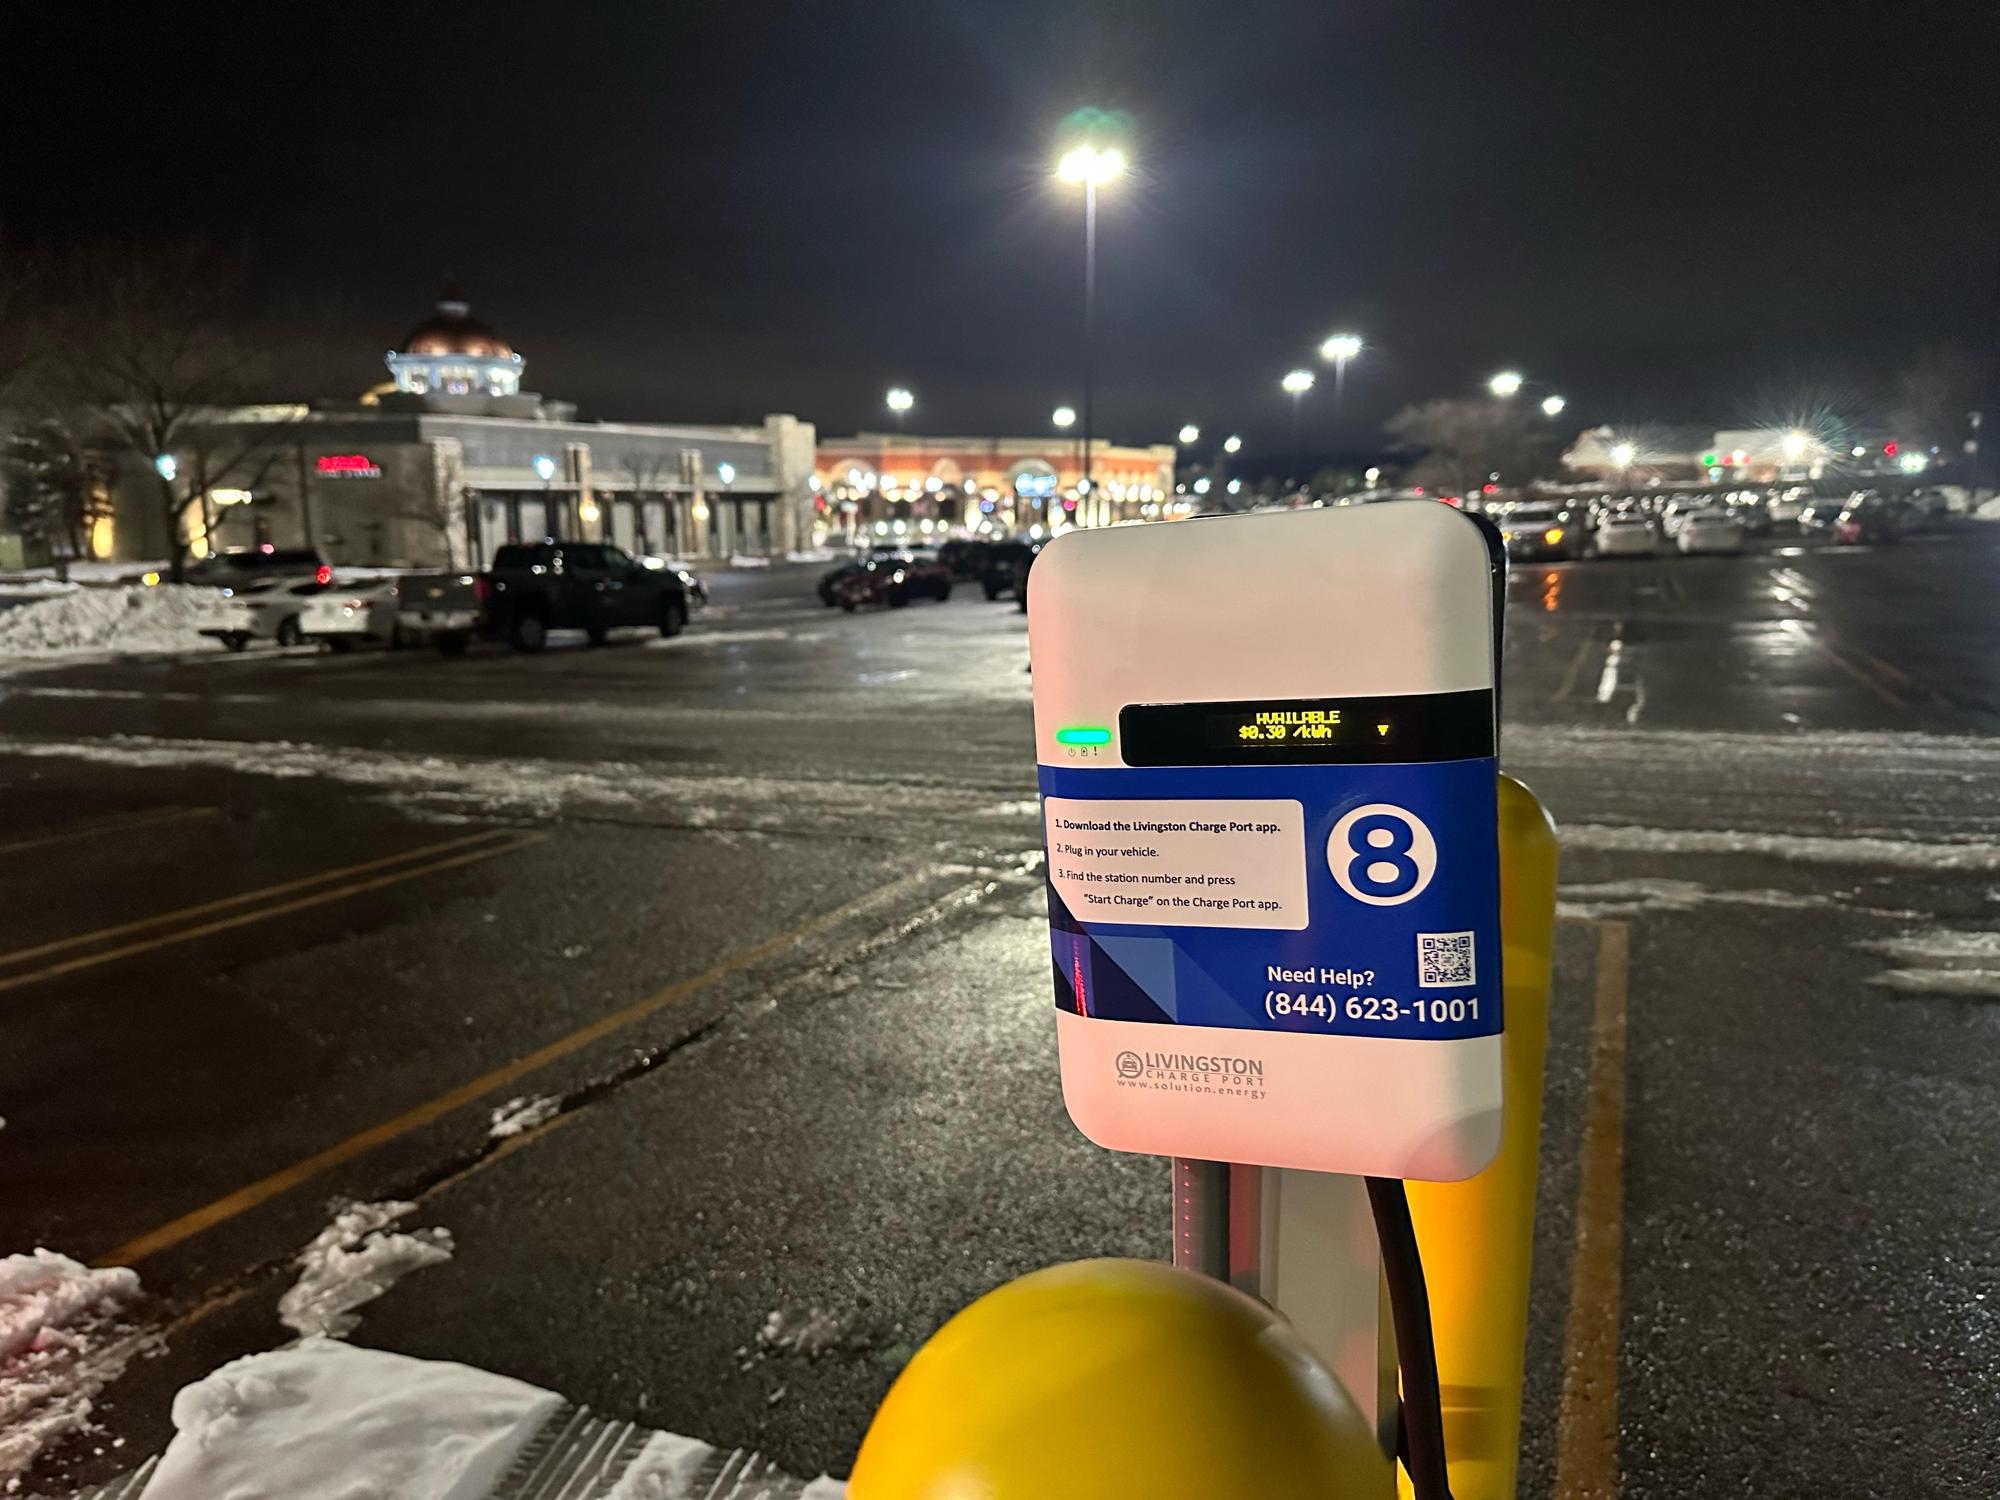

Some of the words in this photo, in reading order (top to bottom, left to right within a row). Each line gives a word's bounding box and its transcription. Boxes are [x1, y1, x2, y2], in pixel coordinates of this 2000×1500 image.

[1256, 710, 1340, 725] AVAILABLE
[1239, 725, 1286, 739] $0.30
[1292, 725, 1332, 739] /kWh
[1055, 819, 1062, 828] 1.
[1064, 820, 1111, 832] Download
[1113, 821, 1131, 832] the
[1133, 821, 1186, 833] Livingston
[1189, 822, 1226, 833] Charge
[1229, 823, 1253, 832] Port
[1256, 824, 1281, 834] app.
[1056, 843, 1063, 853] 2.
[1065, 845, 1082, 857] Plug
[1084, 846, 1093, 856] in
[1095, 848, 1118, 858] your
[1120, 847, 1159, 857] vehicle.
[1348, 814, 1419, 897] 8
[1058, 869, 1066, 878] 3.
[1067, 870, 1084, 881] Find
[1086, 872, 1102, 882] the
[1104, 873, 1139, 883] station
[1141, 874, 1181, 884] number
[1185, 875, 1204, 885] and
[1207, 876, 1236, 887] press
[1156, 898, 1170, 906] on
[1172, 897, 1190, 907] the
[1192, 897, 1230, 909] Charge
[1232, 899, 1255, 909] Port
[1258, 901, 1282, 911] app.
[1268, 966, 1315, 983] Need
[1321, 968, 1375, 989] Help?
[1265, 990, 1337, 1023] (844)
[1345, 997, 1479, 1022] 623-1001
[1145, 1052, 1264, 1075] LIVINGSTON
[1146, 1070, 1210, 1083] CHARGE
[1222, 1075, 1264, 1087] PORT
[1116, 1079, 1267, 1100] www.solution.energy
